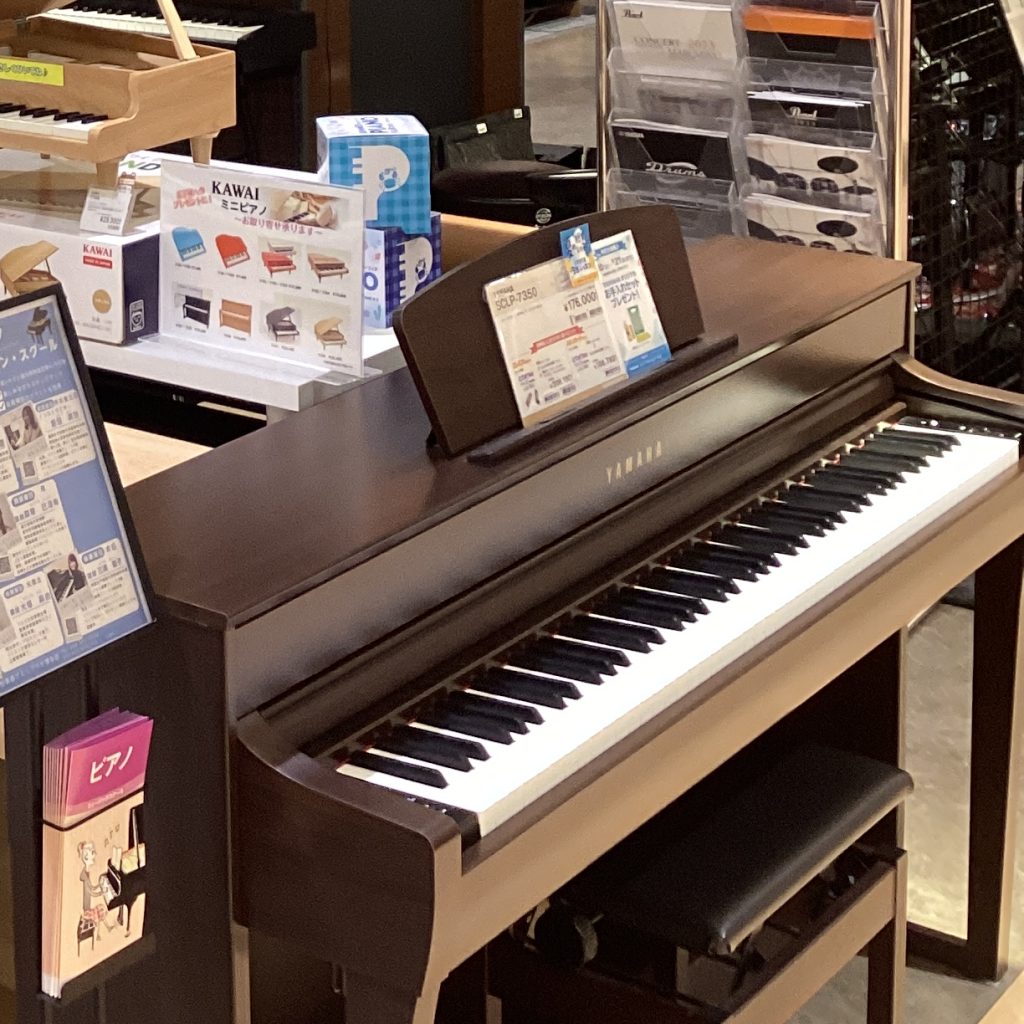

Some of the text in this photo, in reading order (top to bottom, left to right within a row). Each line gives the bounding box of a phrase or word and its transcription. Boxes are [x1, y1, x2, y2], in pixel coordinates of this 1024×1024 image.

[211, 180, 260, 201] KAWAI
[221, 198, 268, 216] ミニピアノ
[82, 243, 114, 259] KAWAI
[89, 745, 134, 785] ピアノ
